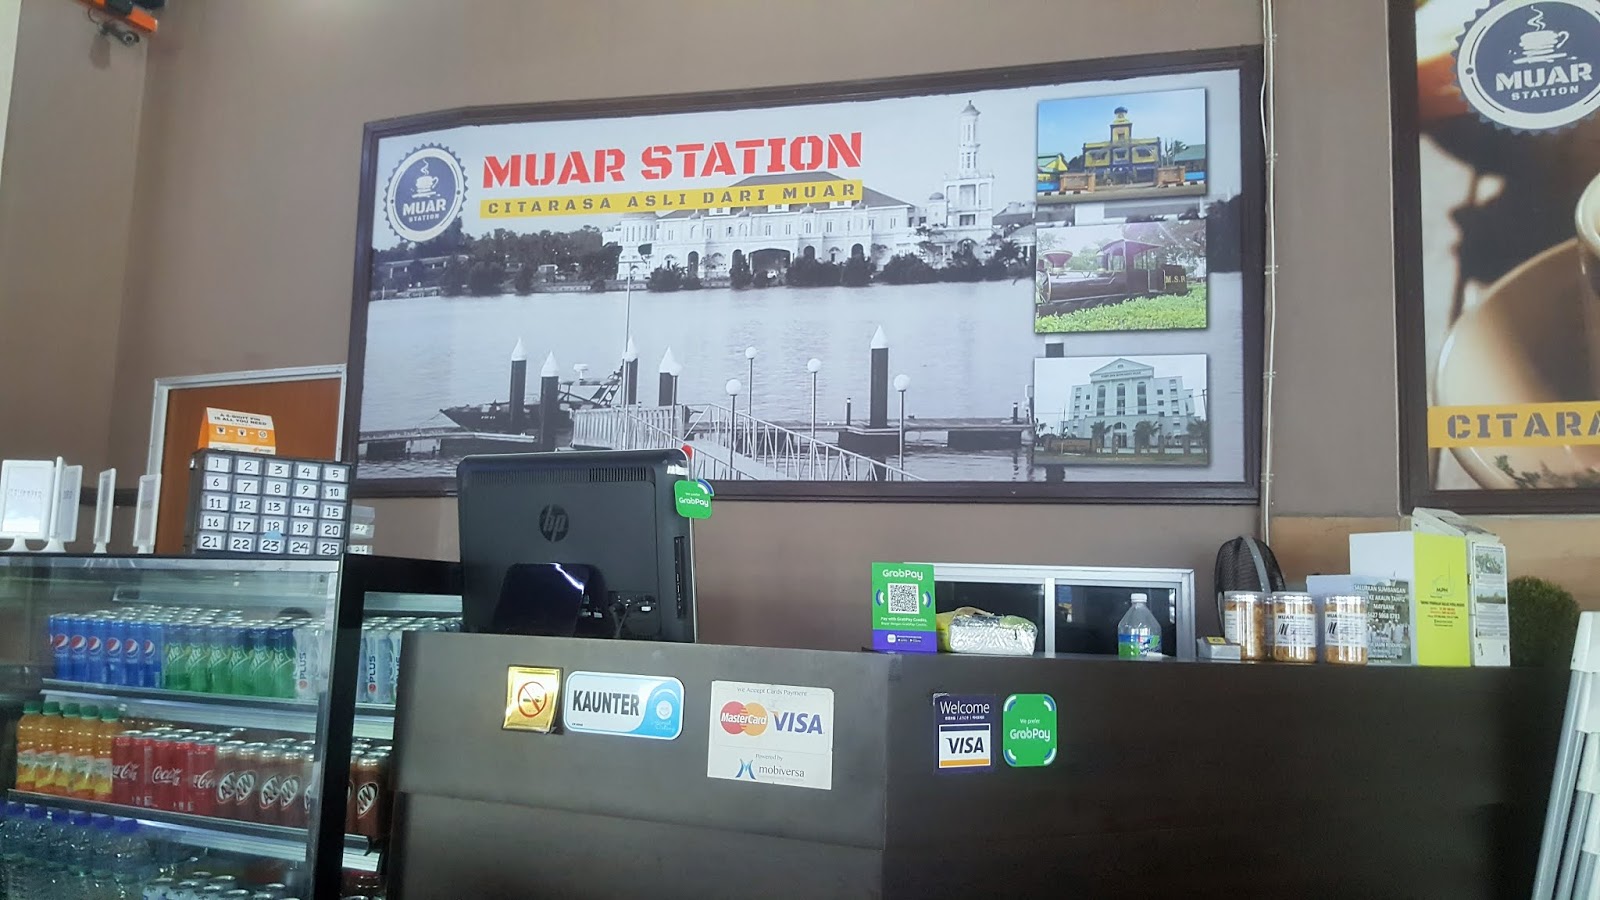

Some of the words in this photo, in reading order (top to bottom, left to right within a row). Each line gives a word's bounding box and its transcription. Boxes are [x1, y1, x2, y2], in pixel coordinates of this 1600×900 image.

[1495, 62, 1593, 91] MUAR
[1511, 85, 1579, 101] STATION
[483, 148, 626, 188] MUAR
[641, 132, 862, 180] STATION
[488, 197, 611, 214] CITARASA
[627, 193, 686, 207] ASLI
[703, 189, 765, 204] DARI
[782, 183, 855, 199] MUAR
[403, 198, 447, 216] MUAR
[409, 213, 440, 222] STATION
[216, 460, 219, 468] 1
[244, 462, 252, 471] 2
[275, 466, 283, 474] 3
[302, 467, 311, 477] 4
[332, 470, 340, 478] 5
[213, 477, 219, 487] 6
[243, 482, 251, 492] 7
[275, 484, 281, 493] 8
[302, 486, 309, 495] 9
[329, 488, 339, 497] 10
[209, 499, 222, 509] 11
[239, 500, 251, 510] 12
[268, 502, 281, 512] 13
[679, 497, 709, 507] GrabPay
[297, 505, 311, 515] 14
[326, 508, 339, 517] 15
[207, 518, 219, 527] 16
[237, 521, 250, 531] 17
[267, 521, 280, 531] 18
[543, 504, 567, 542] hp
[297, 524, 309, 533] 19
[325, 525, 339, 535] 20
[202, 536, 218, 548] 21
[233, 539, 250, 550] 22
[262, 540, 279, 552] 23
[292, 542, 309, 553] 24
[321, 543, 338, 555] 25
[882, 568, 923, 581] GrabPay
[573, 690, 640, 716] KAUNTER
[940, 700, 990, 715] Welcome
[721, 712, 767, 725] MasterCard
[770, 710, 823, 735] VISA
[1010, 727, 1051, 742] GrabPay
[946, 737, 984, 754] VISA
[759, 765, 805, 778] mobiversa
